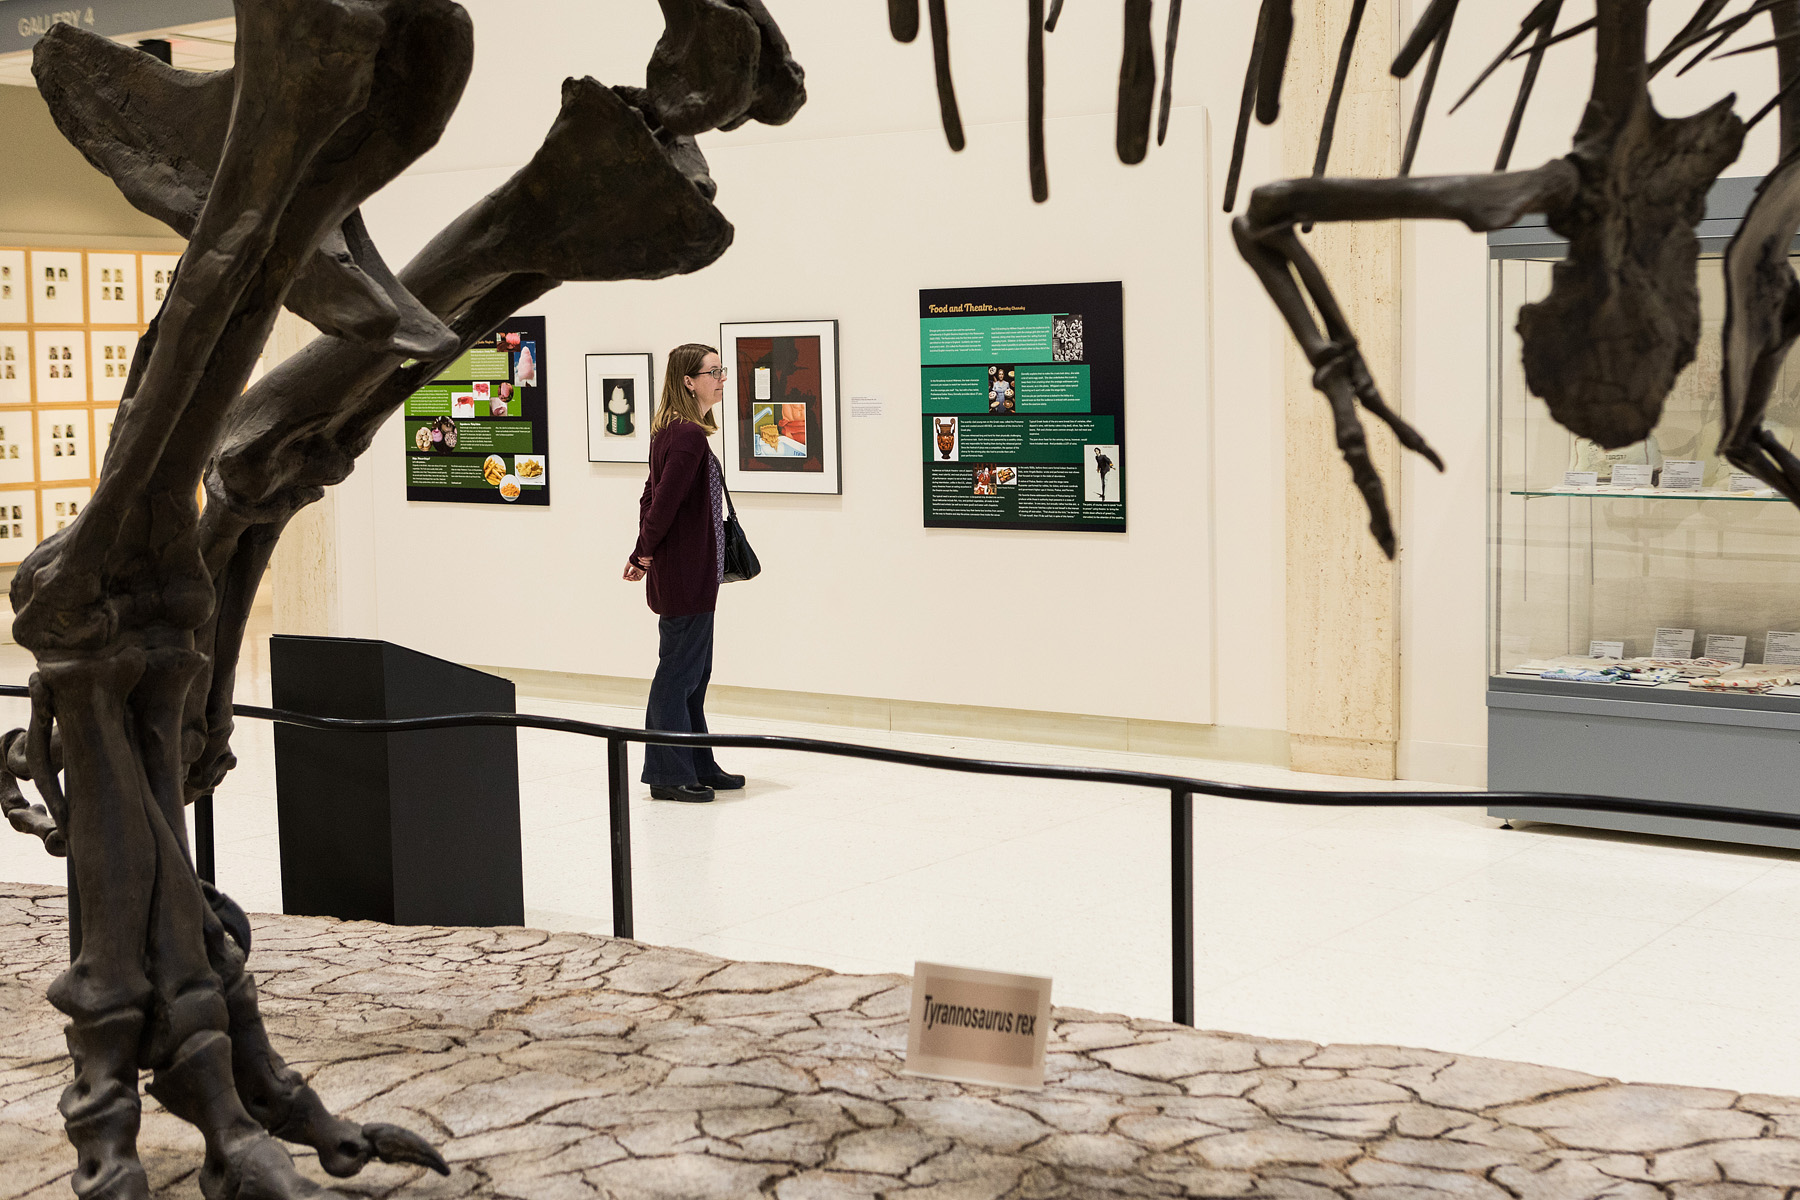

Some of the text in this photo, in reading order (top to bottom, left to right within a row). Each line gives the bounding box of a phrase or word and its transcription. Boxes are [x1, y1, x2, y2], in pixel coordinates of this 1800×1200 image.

[84, 7, 95, 26] 4
[929, 304, 948, 313] Food
[949, 304, 963, 313] and
[964, 303, 993, 312] Theatre
[923, 994, 1037, 1037] Tyrannosaurus rex
